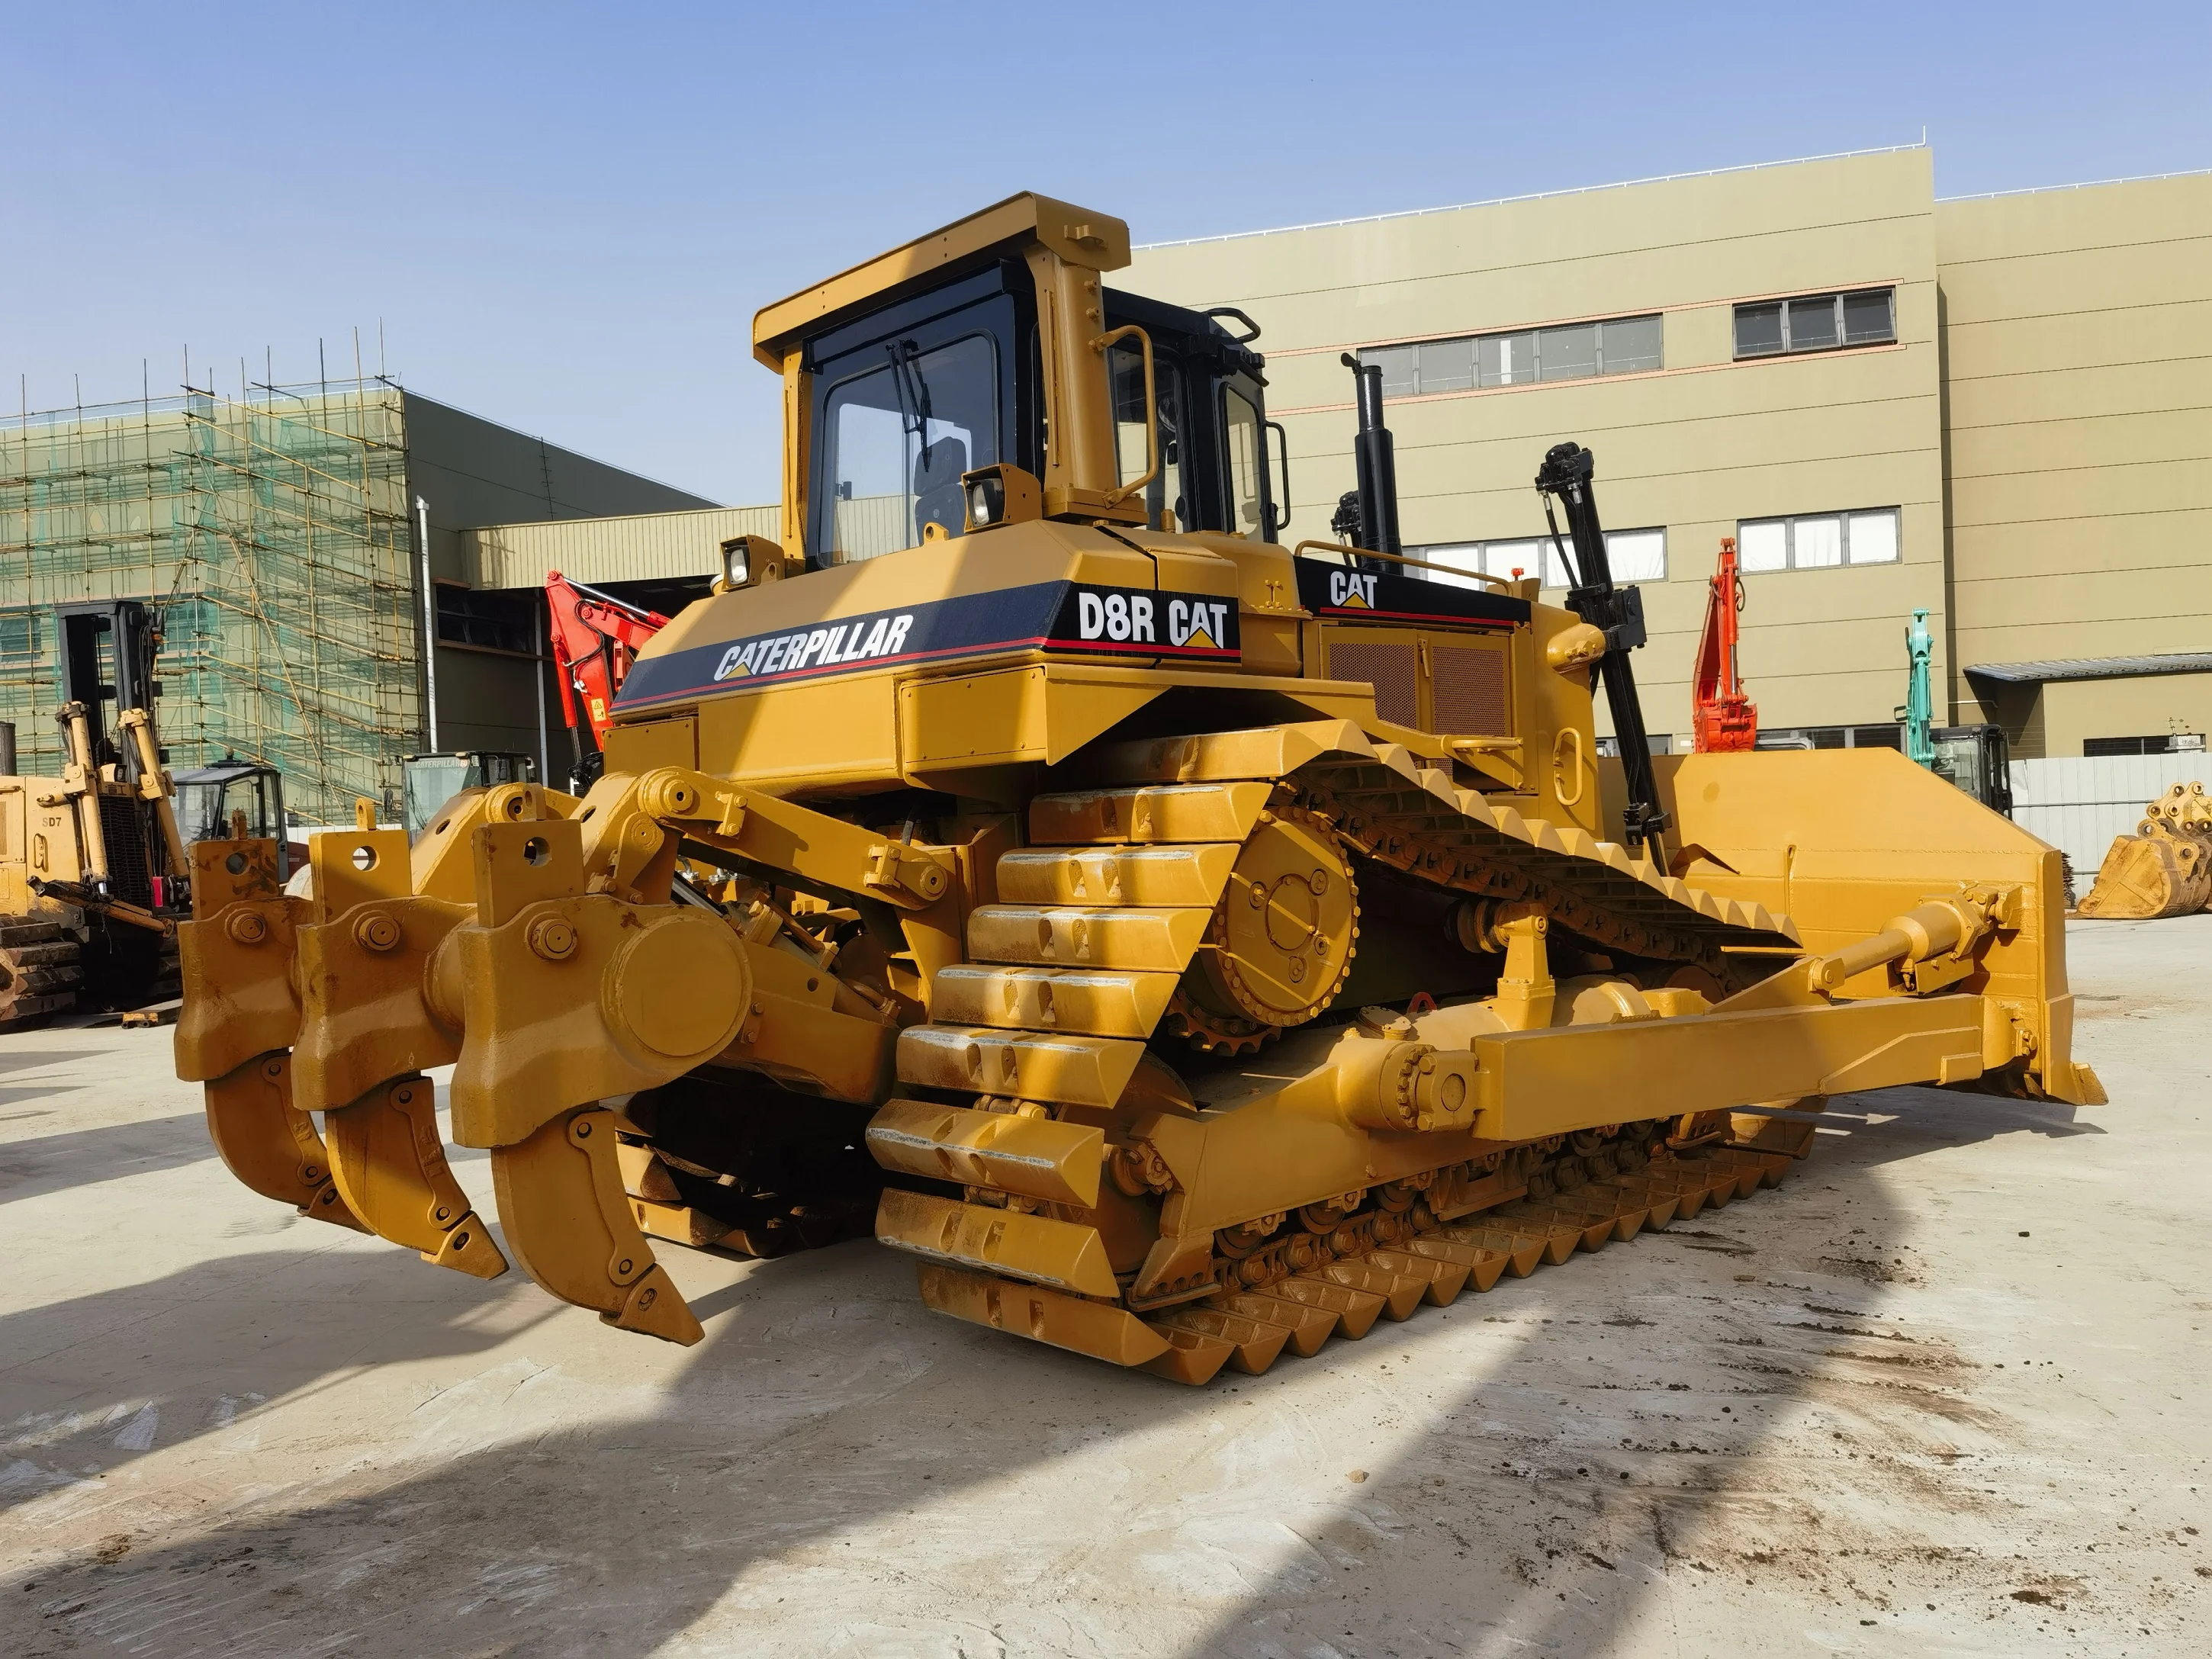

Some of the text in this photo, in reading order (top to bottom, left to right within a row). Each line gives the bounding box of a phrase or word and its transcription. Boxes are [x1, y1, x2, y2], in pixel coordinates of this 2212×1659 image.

[1330, 571, 1378, 609] CAT
[1079, 592, 1228, 649] D8R CAT
[713, 614, 914, 681] CATERPILLAR
[416, 758, 460, 769] CATERPILLAR
[42, 817, 62, 827] SD7
